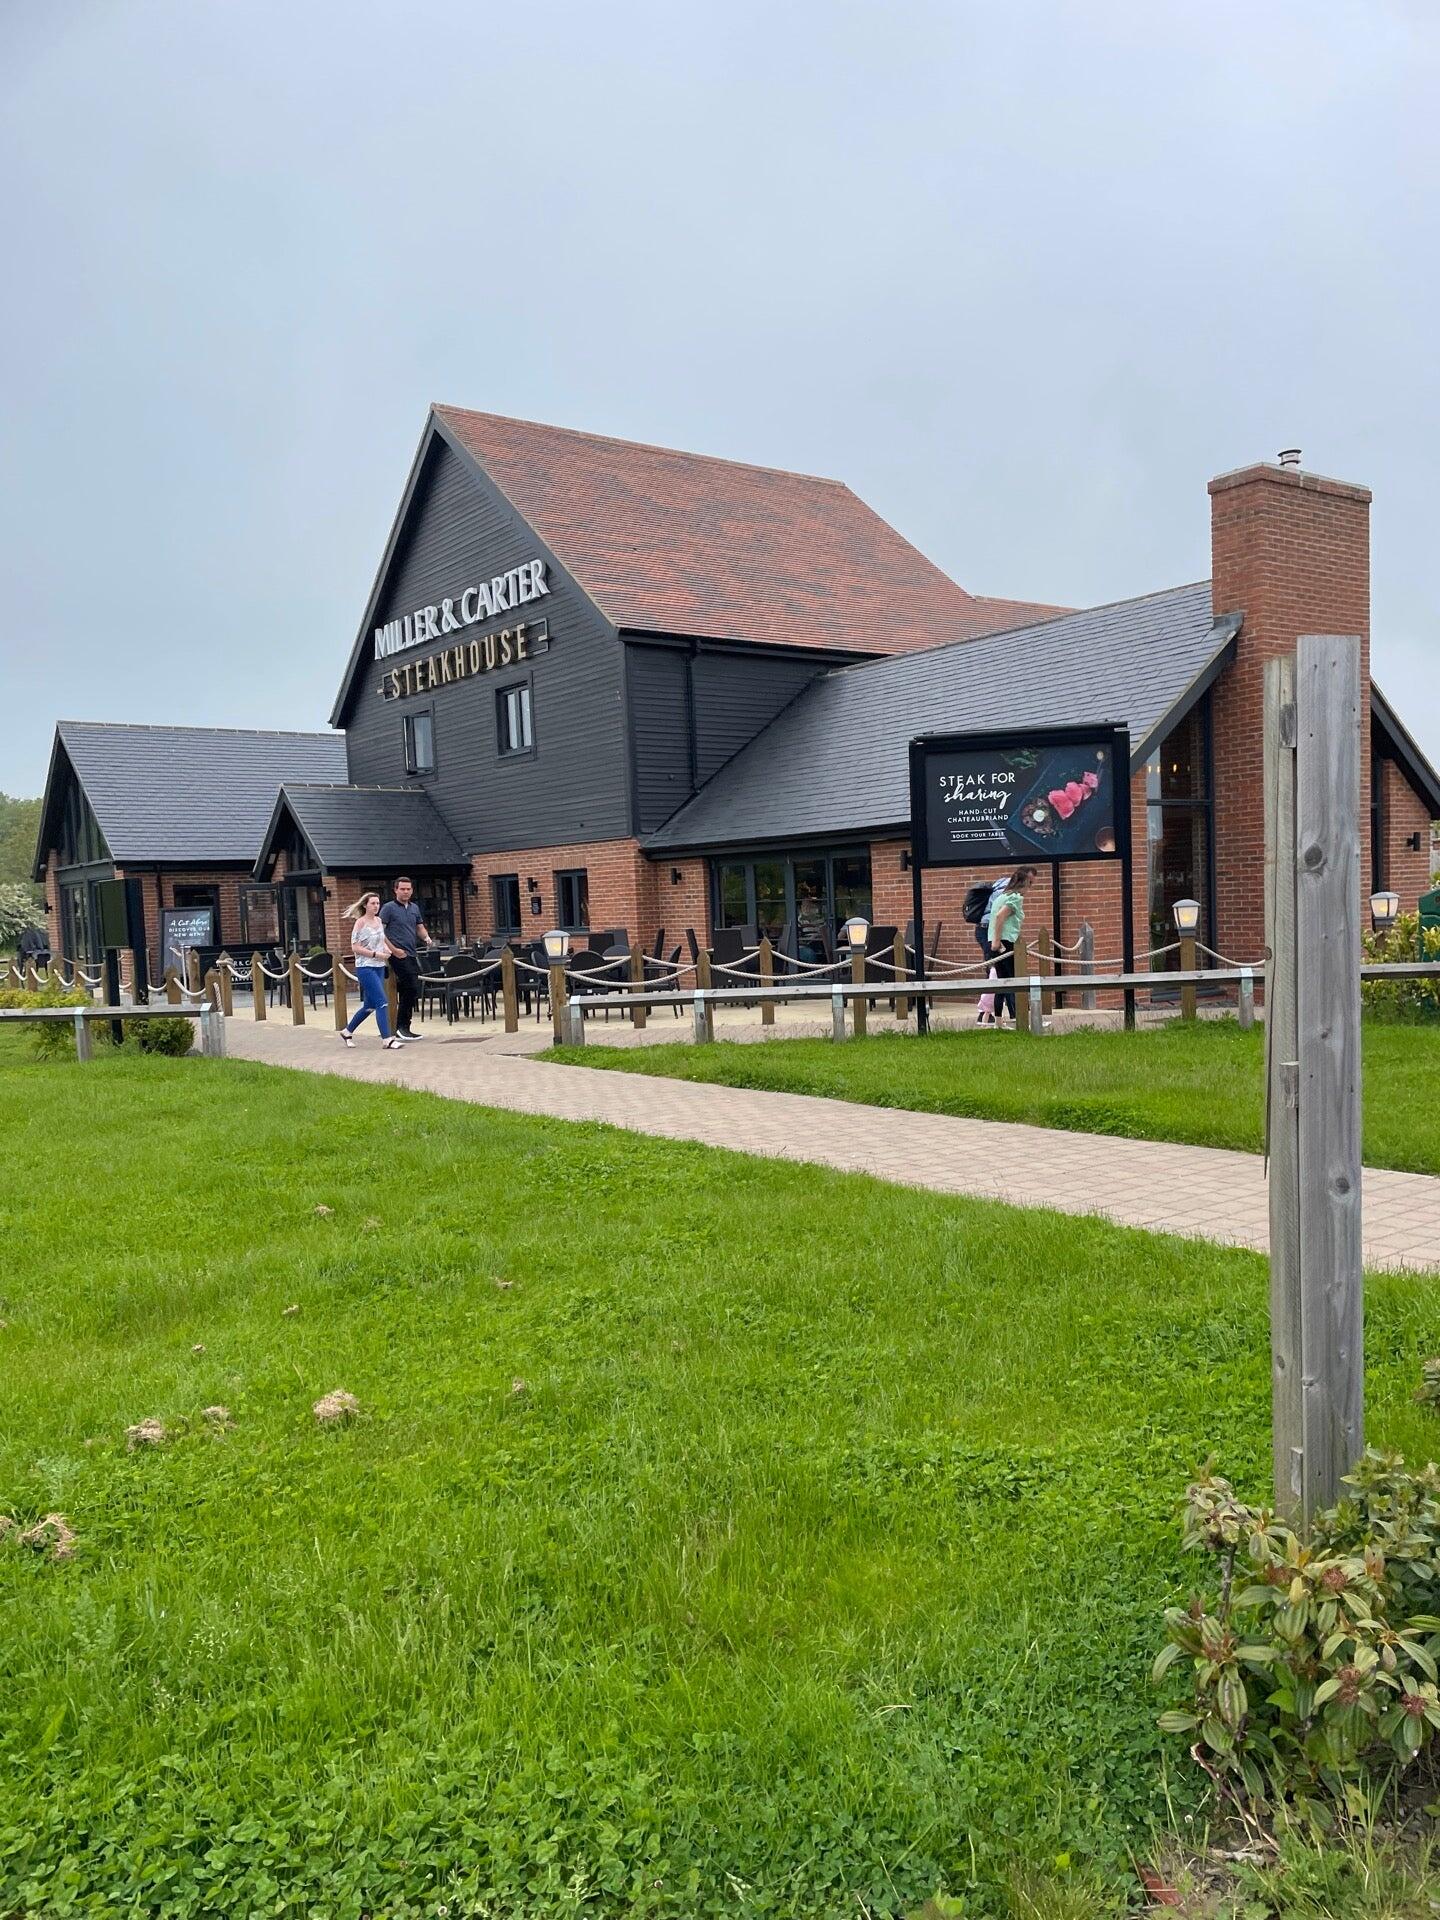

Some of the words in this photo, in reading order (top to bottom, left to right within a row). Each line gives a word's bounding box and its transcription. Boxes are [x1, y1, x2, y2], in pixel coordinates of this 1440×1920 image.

[374, 605, 442, 660] MILLER
[461, 559, 551, 624] CARTER
[391, 623, 528, 698] STEAKHOUSE
[939, 774, 986, 787] STEAK
[991, 772, 1016, 784] FOR
[944, 783, 1012, 810] sharing
[947, 814, 1009, 824] CHATEAUBRIAND
